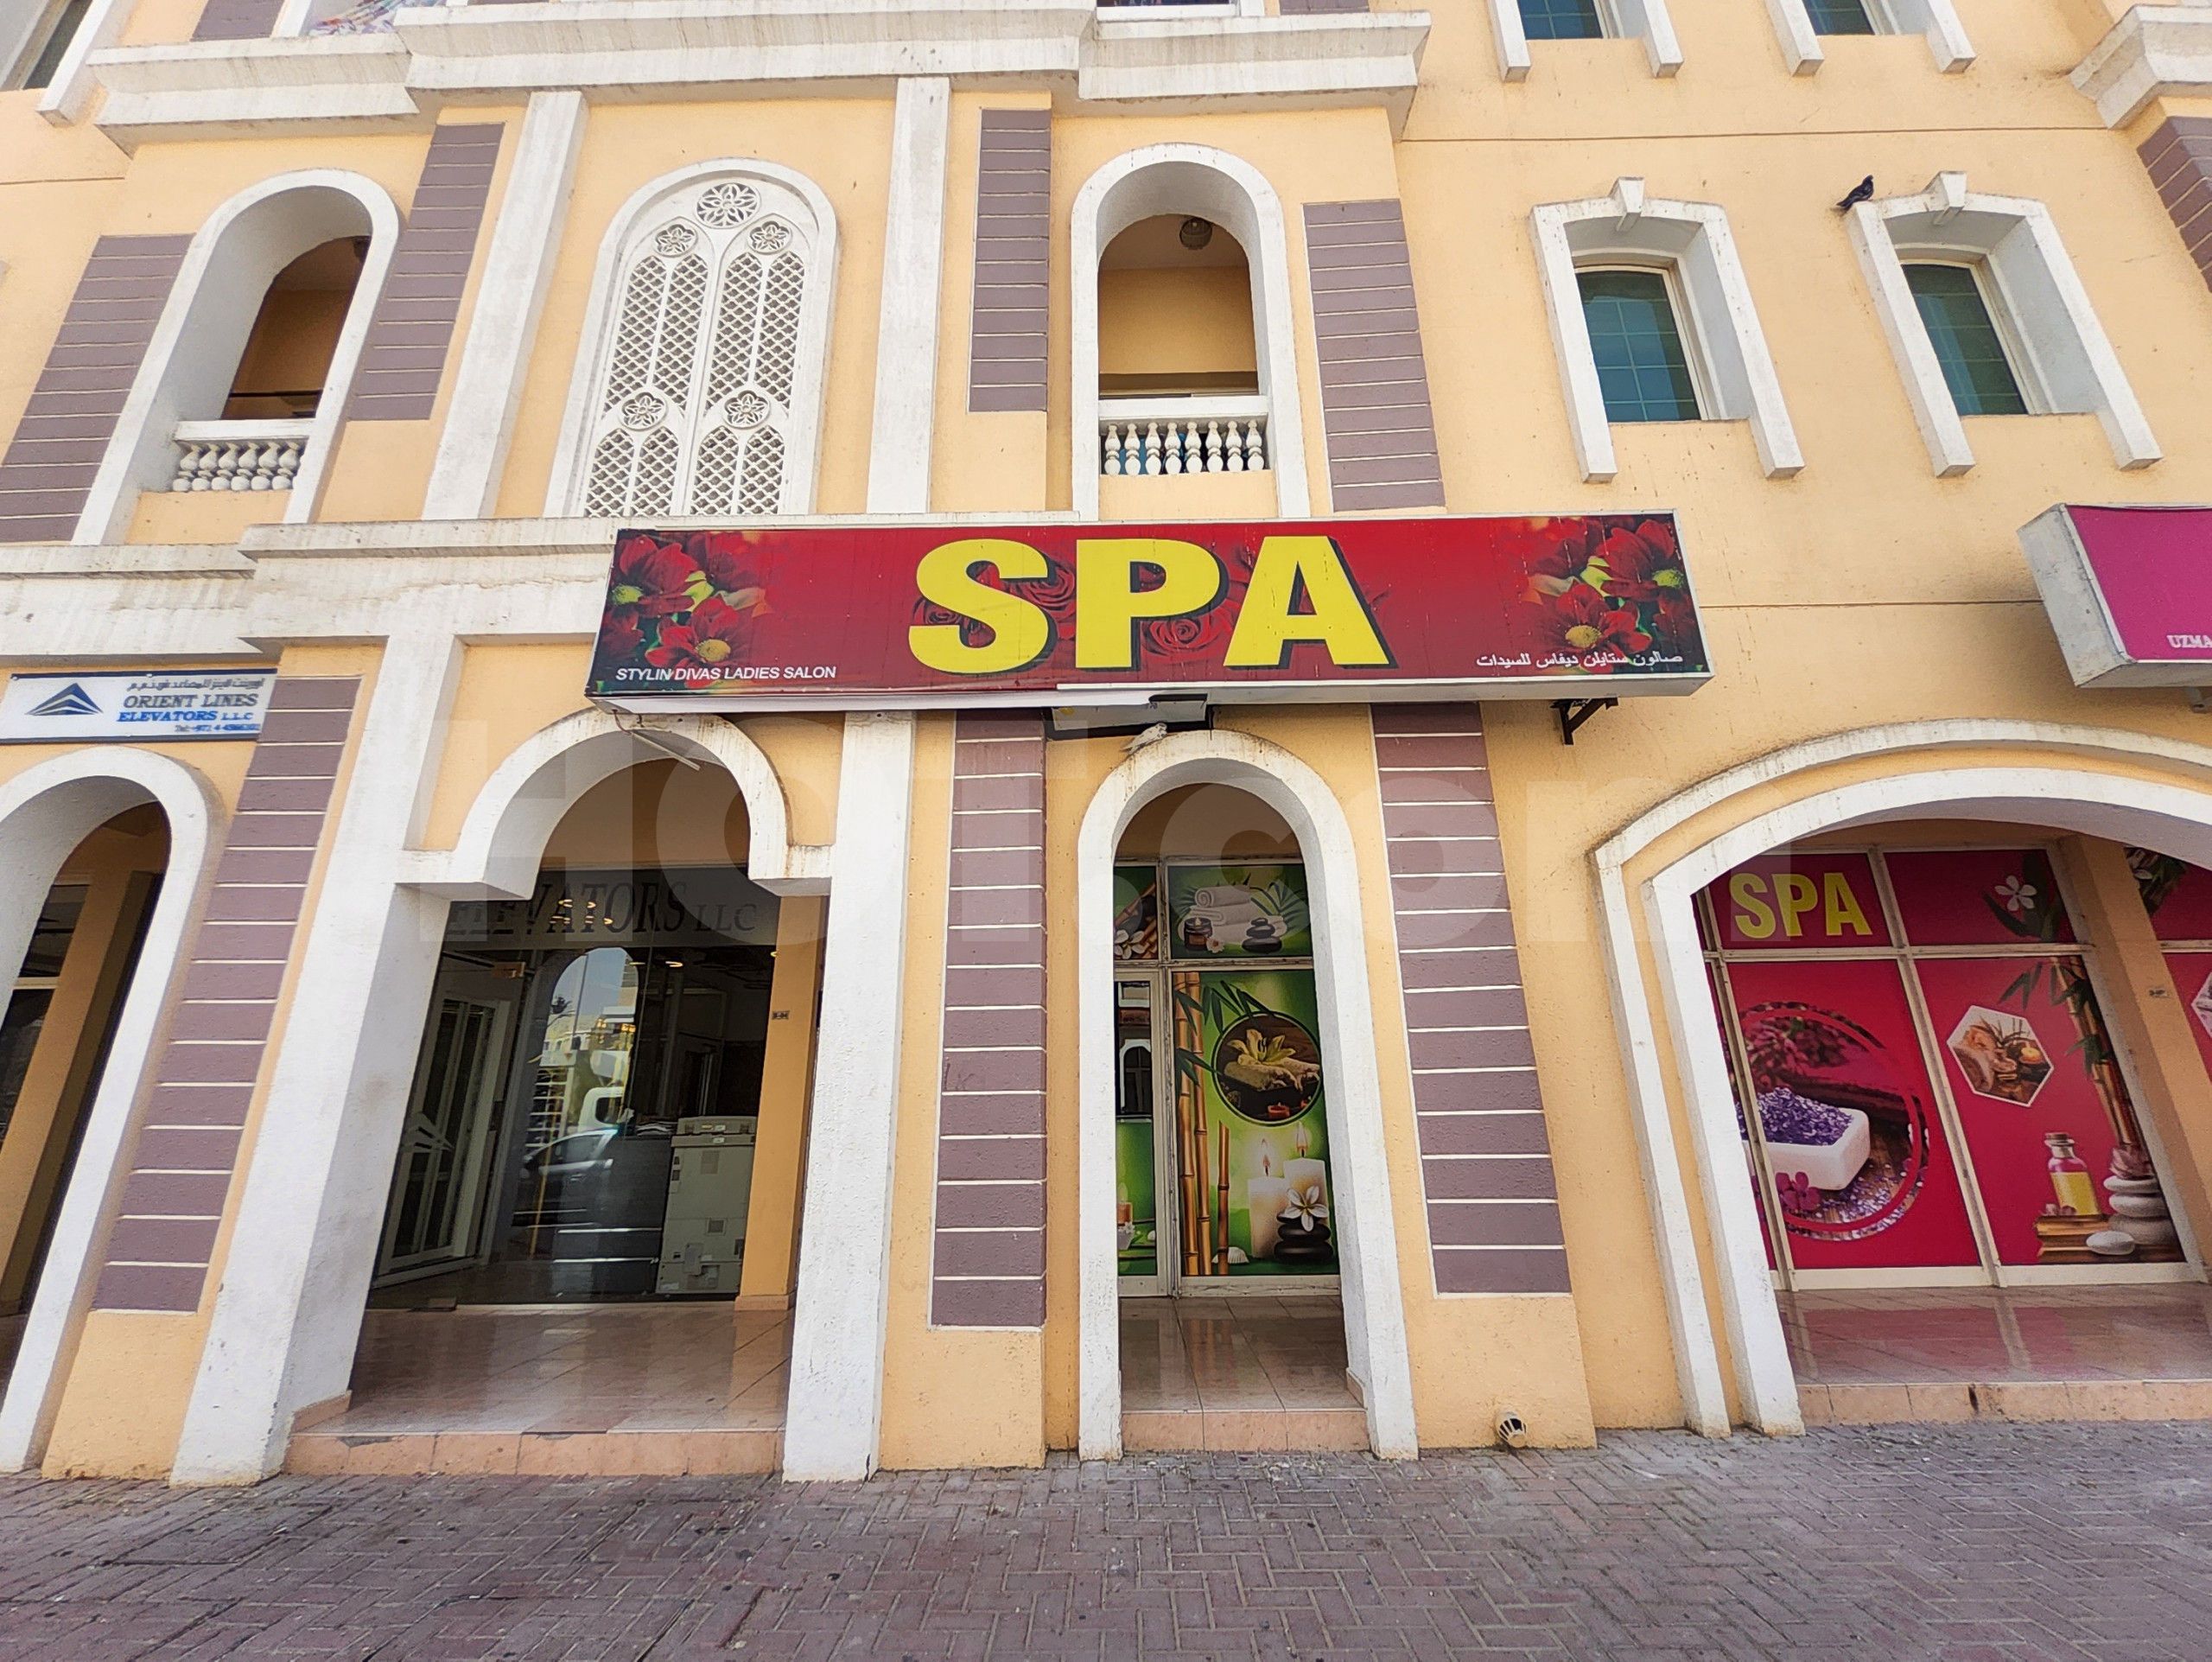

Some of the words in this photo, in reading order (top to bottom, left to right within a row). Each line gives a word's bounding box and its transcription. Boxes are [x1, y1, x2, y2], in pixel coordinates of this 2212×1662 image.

[908, 535, 1398, 675] SPA
[1476, 653, 1531, 667] للسيدات
[1535, 652, 1579, 668] ديفاس
[1583, 652, 1630, 668] ستايلن
[1633, 651, 1683, 667] صالون
[615, 667, 671, 681] STYLIN
[674, 668, 721, 681] DIVAS
[723, 667, 779, 680] LADIES
[783, 665, 836, 679] SALON
[124, 694, 199, 709] ORIENT
[200, 692, 259, 708] LINES
[117, 710, 219, 723] ELEVATORS
[1730, 872, 1873, 939] SPA
[694, 903, 757, 933] LLC
